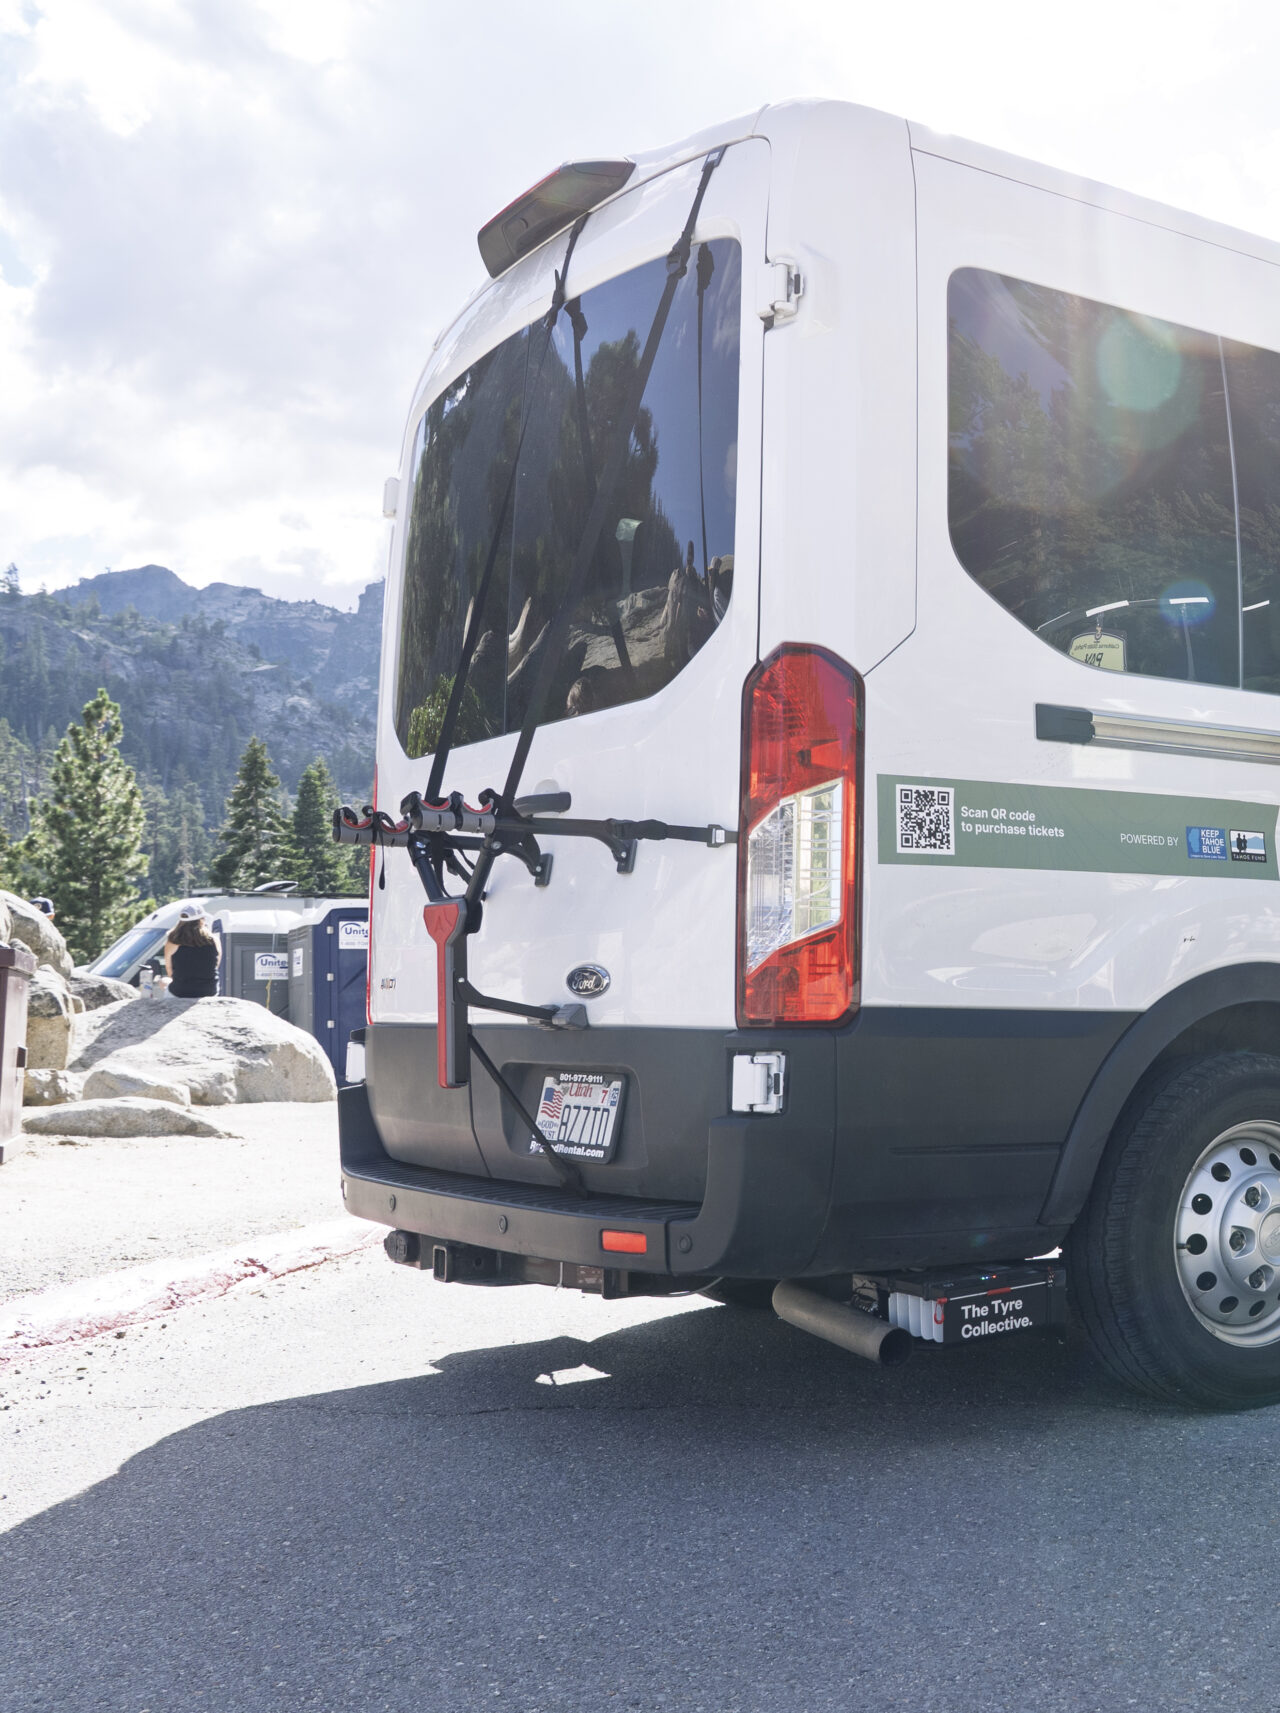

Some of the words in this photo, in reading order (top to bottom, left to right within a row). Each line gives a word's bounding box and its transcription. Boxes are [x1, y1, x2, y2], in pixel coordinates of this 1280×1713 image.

[961, 806, 989, 819] Scan
[991, 808, 1007, 820] QR
[1009, 810, 1036, 821] code
[961, 821, 973, 832] to
[975, 823, 1027, 835] purchase
[1028, 824, 1065, 837] tickets
[1200, 829, 1220, 838] KEEP
[1120, 833, 1165, 846] POWERED
[1167, 835, 1179, 847] BY
[1201, 837, 1225, 847] TAHOE
[1202, 845, 1222, 854] BLUE
[571, 971, 596, 990] Ford
[559, 1073, 603, 1083] 801-977-9111
[568, 1082, 593, 1098] Utah
[601, 1089, 609, 1104] 7
[961, 1304, 989, 1319] The
[991, 1298, 1023, 1316] Tyre
[961, 1315, 1033, 1339] Collective.
